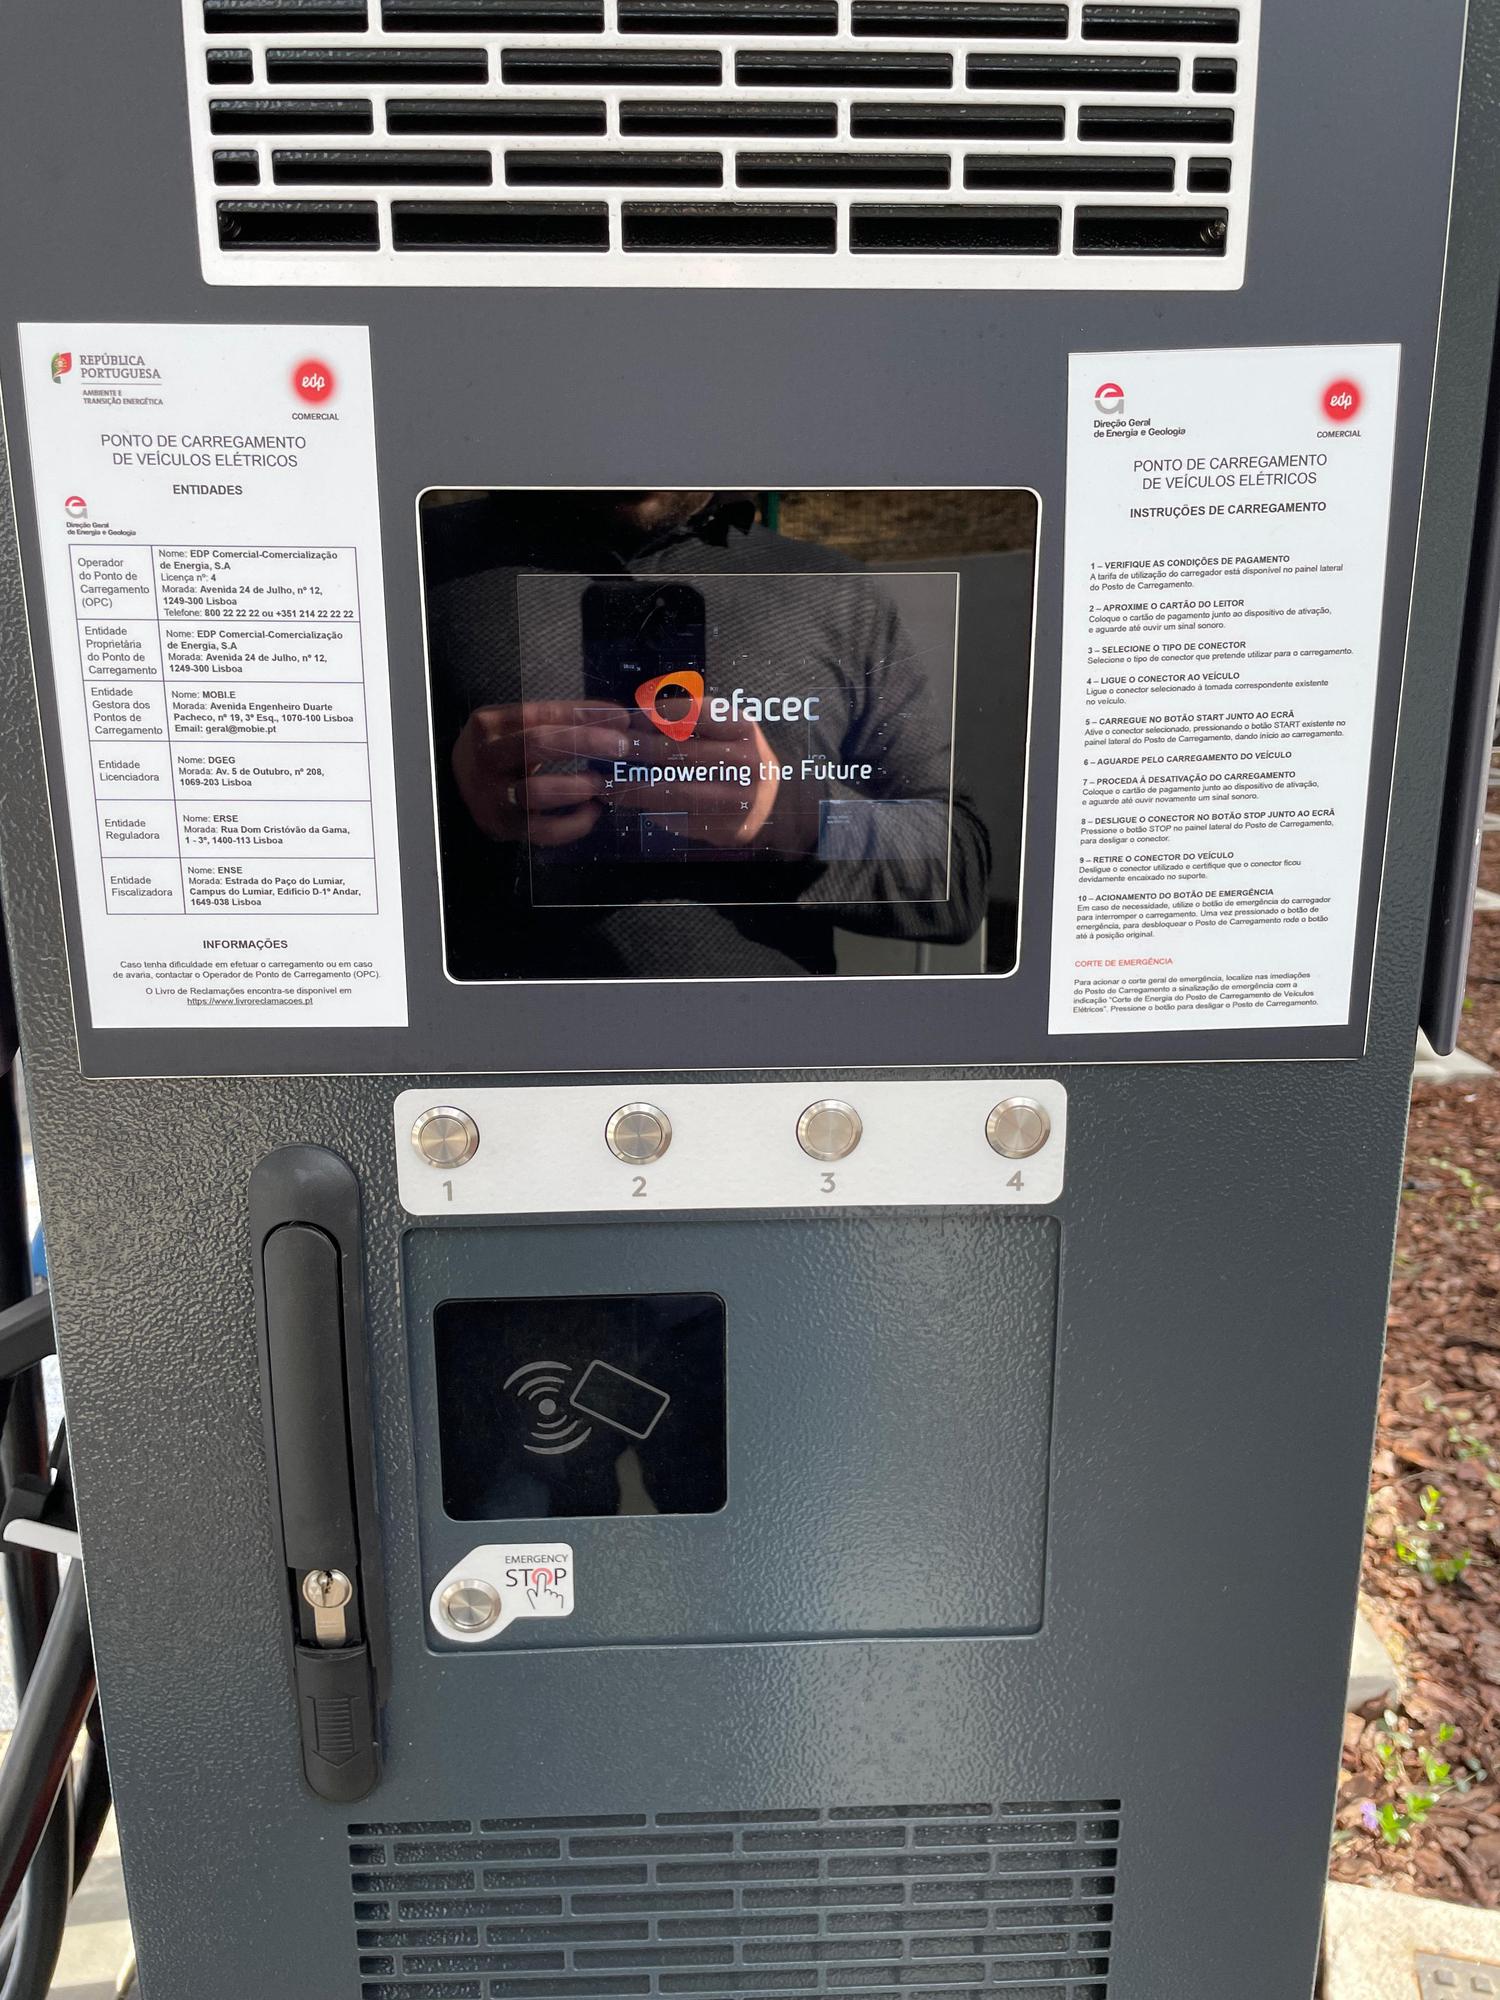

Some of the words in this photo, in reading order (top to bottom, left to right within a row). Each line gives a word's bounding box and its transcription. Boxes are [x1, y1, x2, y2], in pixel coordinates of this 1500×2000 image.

[79, 353, 146, 366] REPÚBLICA
[80, 368, 162, 379] PORTUGUESA
[302, 372, 326, 391] edp
[1329, 392, 1352, 410] edp
[292, 412, 340, 421] COMERCIAL
[1094, 419, 1126, 429] Direção
[1129, 418, 1151, 427] Geral
[1094, 430, 1104, 438] de
[1106, 429, 1138, 439] Energia
[1148, 427, 1186, 437] Geologia
[1317, 430, 1361, 438] COMERCIAL
[101, 434, 153, 447] PONTO
[157, 435, 177, 448] DE
[182, 435, 306, 449] CARREGAMENTO
[113, 453, 133, 465] DE
[136, 451, 211, 467] VEÍCULOS
[215, 452, 298, 468] ELÉTRICOS
[1134, 459, 1183, 472] PONTO
[1187, 458, 1206, 470] DE
[1210, 454, 1327, 470] CARREGAMENTO
[1143, 477, 1161, 490] DE
[1166, 474, 1235, 489] VEÍCULOS
[1239, 471, 1317, 486] ELÉTRICOS
[173, 484, 243, 495] ENTIDADES
[1130, 504, 1206, 519] INSTRUÇÕES
[1209, 505, 1224, 515] DE
[1228, 502, 1327, 514] CARREGAMENTO
[159, 549, 188, 558] Nome:
[190, 549, 210, 558] EDP
[212, 550, 338, 561] Comercial-Comercialização
[77, 557, 124, 569] Operador
[160, 561, 171, 570] de
[174, 561, 212, 572] Energia,
[1105, 560, 1151, 569] VERIFIQUE
[1152, 560, 1165, 568] AS
[1167, 557, 1219, 568] CONDIÇÕES
[1221, 557, 1233, 565] DE
[1235, 555, 1290, 565] PAGAMENTO
[79, 571, 92, 580] do
[94, 571, 123, 581] Ponto
[125, 571, 138, 581] de
[161, 573, 194, 583] Licença
[211, 574, 216, 582] 4
[80, 584, 150, 596] Carregamento
[162, 585, 197, 593] Morada:
[200, 585, 237, 594] Avenida
[239, 586, 250, 594] 24
[253, 586, 264, 594] de
[266, 586, 295, 595] Julho,
[310, 586, 323, 596] 12,
[82, 597, 113, 609] (OPC)
[164, 597, 204, 605] 1249-300
[206, 597, 237, 606] Lisboa
[1103, 603, 1148, 612] APROXIME
[1160, 600, 1196, 610] CARTÃO
[1213, 599, 1244, 608] LEITOR
[164, 608, 202, 616] Telefone:
[205, 609, 221, 617] 800
[223, 609, 234, 617] 22
[236, 609, 247, 617] 22
[249, 609, 260, 617] 22
[276, 610, 296, 618] +351
[299, 610, 315, 618] 214
[317, 610, 328, 618] 22
[330, 610, 341, 618] 22
[343, 610, 354, 618] 22
[1101, 676, 1126, 684] LIGUE
[1138, 674, 1186, 683] CONECTOR
[1202, 671, 1240, 680] VEÍCULO
[91, 687, 133, 696] Entidade
[172, 691, 200, 699] Nome:
[92, 700, 130, 709] Gestora
[133, 700, 150, 710] dos
[173, 702, 207, 710] Morada:
[210, 702, 247, 710] Avenida
[249, 702, 301, 712] Engenheiro
[303, 703, 333, 711] Duarte
[710, 688, 820, 722] efacec
[94, 713, 127, 722] Pontos
[130, 713, 142, 722] de
[174, 713, 216, 722] Pacheco,
[230, 714, 243, 722] 19,
[282, 714, 321, 722] 1070-100
[323, 714, 354, 722] Lisboa
[95, 726, 163, 736] Carregamento
[175, 724, 203, 732] Email:
[206, 725, 276, 735] geral@mobie.pt
[98, 760, 140, 769] Entidade
[178, 756, 206, 764] Nome:
[208, 756, 236, 764] DGEG
[100, 773, 160, 782] Licenciadora
[613, 760, 751, 787] Empowering
[759, 761, 794, 781] the
[801, 760, 872, 780] Future
[104, 819, 146, 827] Entidade
[106, 831, 160, 842] Reguladora
[1134, 854, 1181, 862] CONECTOR
[1197, 851, 1234, 860] VEÍCULO
[218, 866, 243, 874] ENSE
[110, 876, 152, 885] Entidade
[112, 888, 173, 896] Fiscalizadora
[203, 938, 288, 951] INFORMAÇÕES
[1075, 960, 1102, 968] CORTE
[1118, 957, 1173, 966] EMERGÊNCIA
[442, 1180, 453, 1202] 1
[631, 1175, 648, 1197] 2
[820, 1172, 837, 1194] 3
[1006, 1170, 1025, 1192] 4
[505, 1554, 569, 1564] EMERGENCY
[506, 1567, 567, 1587] STOP
